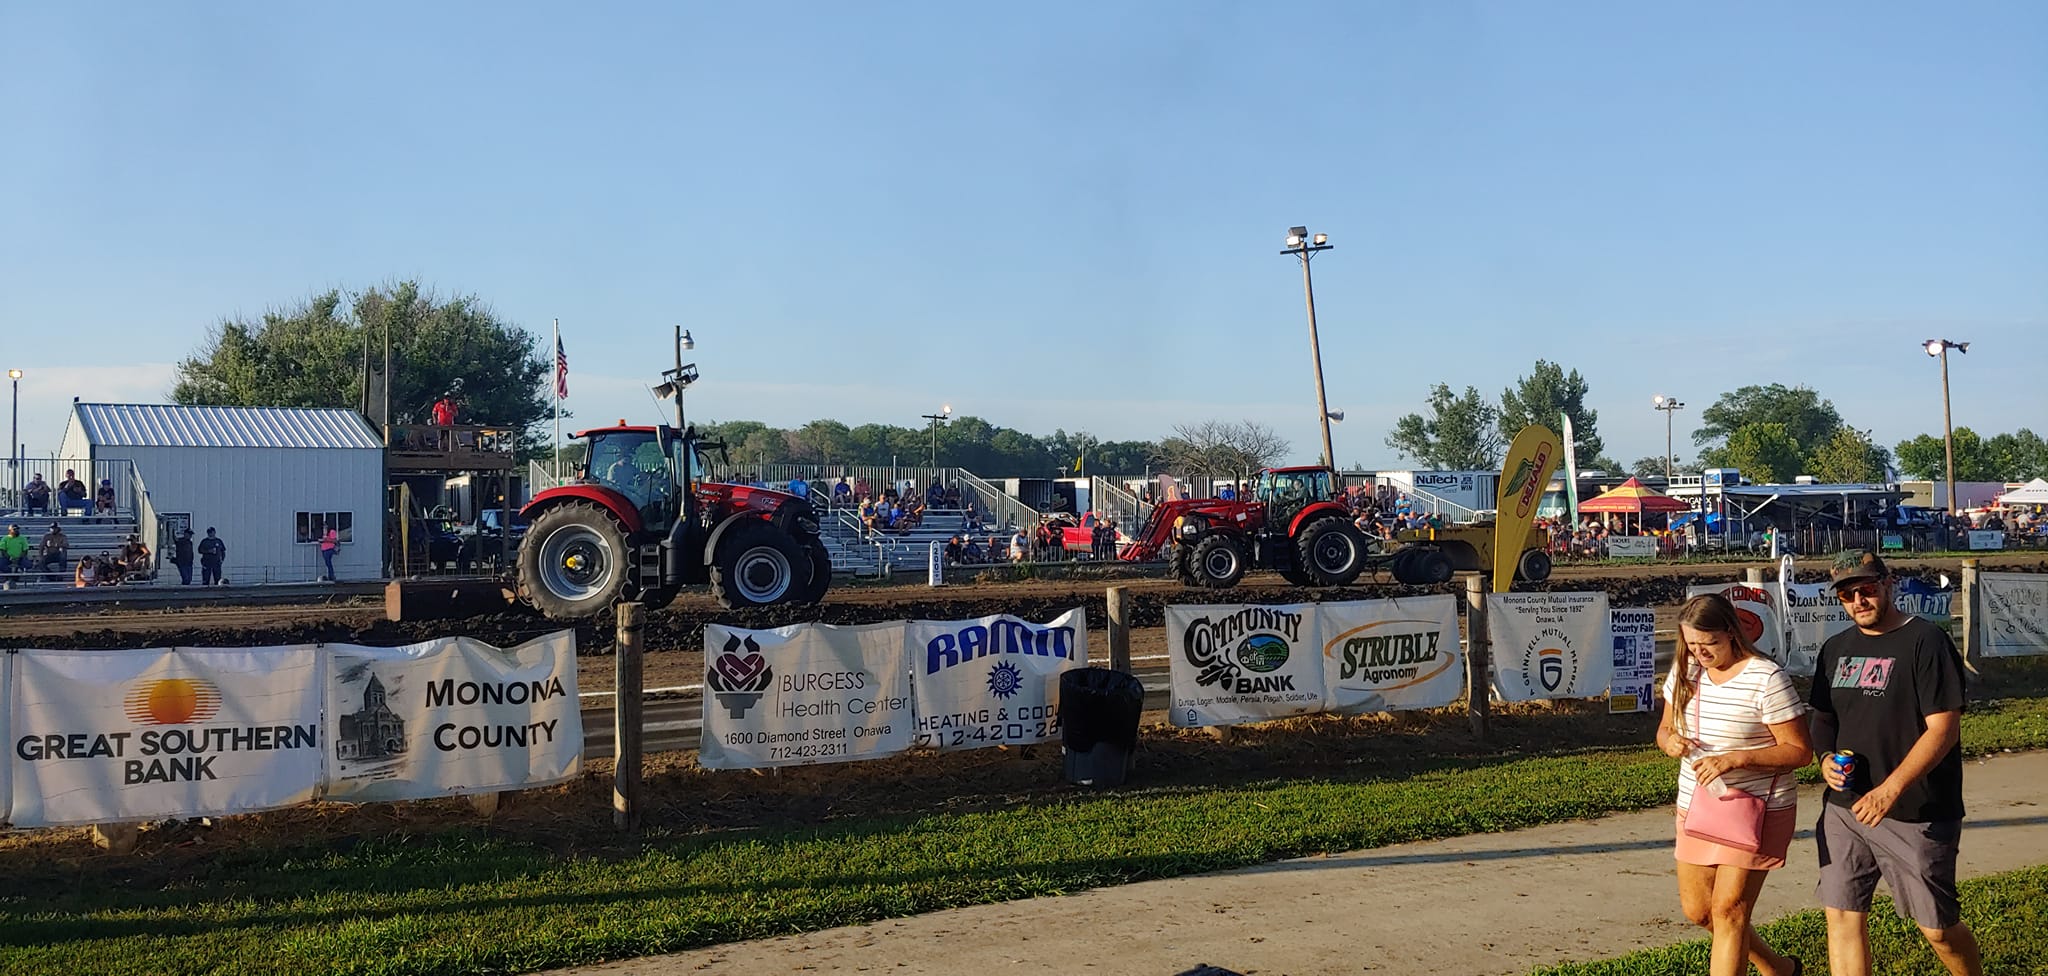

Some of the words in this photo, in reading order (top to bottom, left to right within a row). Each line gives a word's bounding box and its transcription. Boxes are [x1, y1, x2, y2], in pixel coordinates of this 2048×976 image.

[1416, 474, 1458, 484] NuTech
[1521, 452, 1546, 507] DEKALB
[1503, 596, 1526, 604] Monona
[1527, 596, 1547, 605] County
[1548, 596, 1567, 604] Mutual
[1540, 606, 1551, 614] You
[1552, 605, 1568, 613] Since
[1787, 588, 1818, 608] SLOAN
[1611, 611, 1654, 624] Monona
[1611, 624, 1639, 634] County
[1639, 624, 1654, 633] Fair
[927, 619, 1076, 675] RAMM
[1184, 607, 1302, 668] COMMUNITY
[1340, 631, 1440, 680] STRUBLE
[1522, 635, 1541, 687] GRINNELL
[1541, 628, 1571, 649] MUTUAL
[1566, 650, 1578, 694] MEMBER
[782, 671, 865, 692] BURGESS
[1235, 675, 1295, 694] BANK
[1363, 666, 1419, 684] Agronomy
[425, 676, 567, 708] MONONA
[1638, 683, 1653, 711] $4
[1862, 689, 1886, 697] RVCA
[782, 699, 841, 718] Health
[847, 695, 908, 715] Center
[918, 709, 989, 731] HEATING
[997, 708, 1009, 721] &
[16, 732, 131, 761] GREAT
[140, 724, 317, 755] SOUTHERN
[433, 719, 559, 751] COUNTY
[724, 732, 753, 745] 1600
[757, 729, 809, 744] Diamond
[812, 727, 846, 742] Street
[854, 725, 892, 738] Onawa
[919, 724, 1060, 748] 712-420-26
[770, 743, 847, 759] 712-423-2311
[124, 755, 218, 785] BANK
